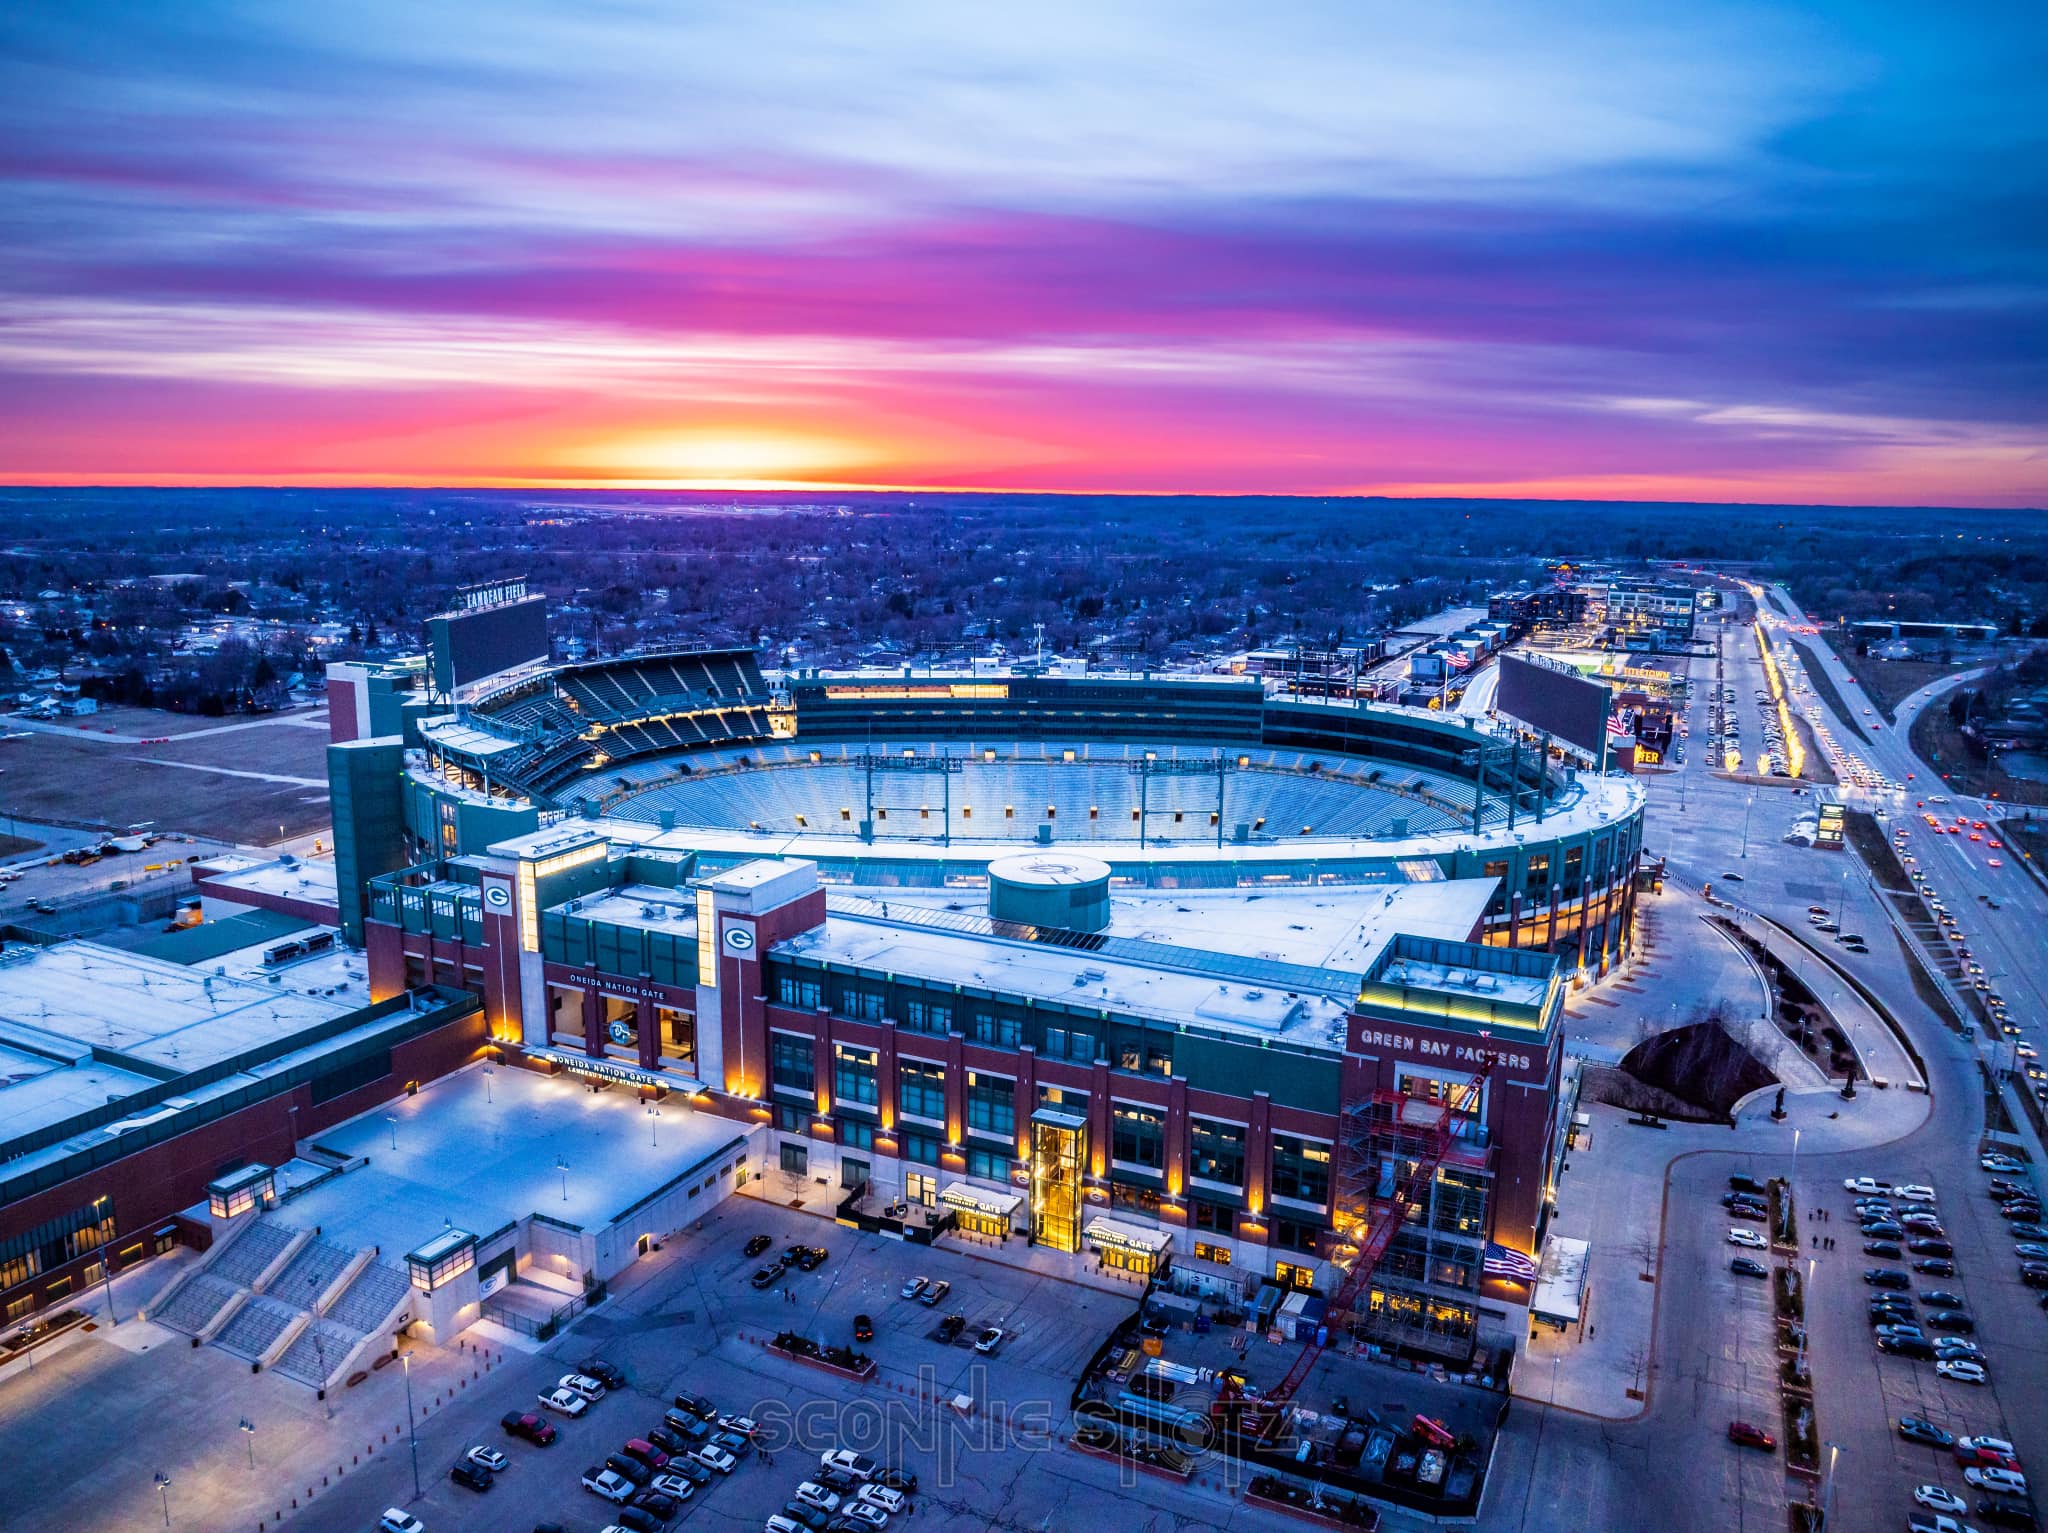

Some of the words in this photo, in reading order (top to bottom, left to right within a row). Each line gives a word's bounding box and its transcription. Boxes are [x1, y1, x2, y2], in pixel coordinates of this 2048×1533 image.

[467, 587, 503, 608] LAMBEAU
[505, 584, 526, 600] FIELD
[1624, 666, 1670, 679] TITLETOWN
[570, 974, 601, 987] ONEIDA
[605, 981, 638, 994] NATION
[641, 989, 665, 1000] GATE
[1361, 1029, 1414, 1050] GREEN
[1420, 1040, 1450, 1056] BAY
[558, 1056, 590, 1070] ONEIDA
[594, 1063, 626, 1078] NATION
[629, 1072, 653, 1084] GATE
[979, 1202, 1001, 1214] GATE
[1129, 1239, 1153, 1251] GATE
